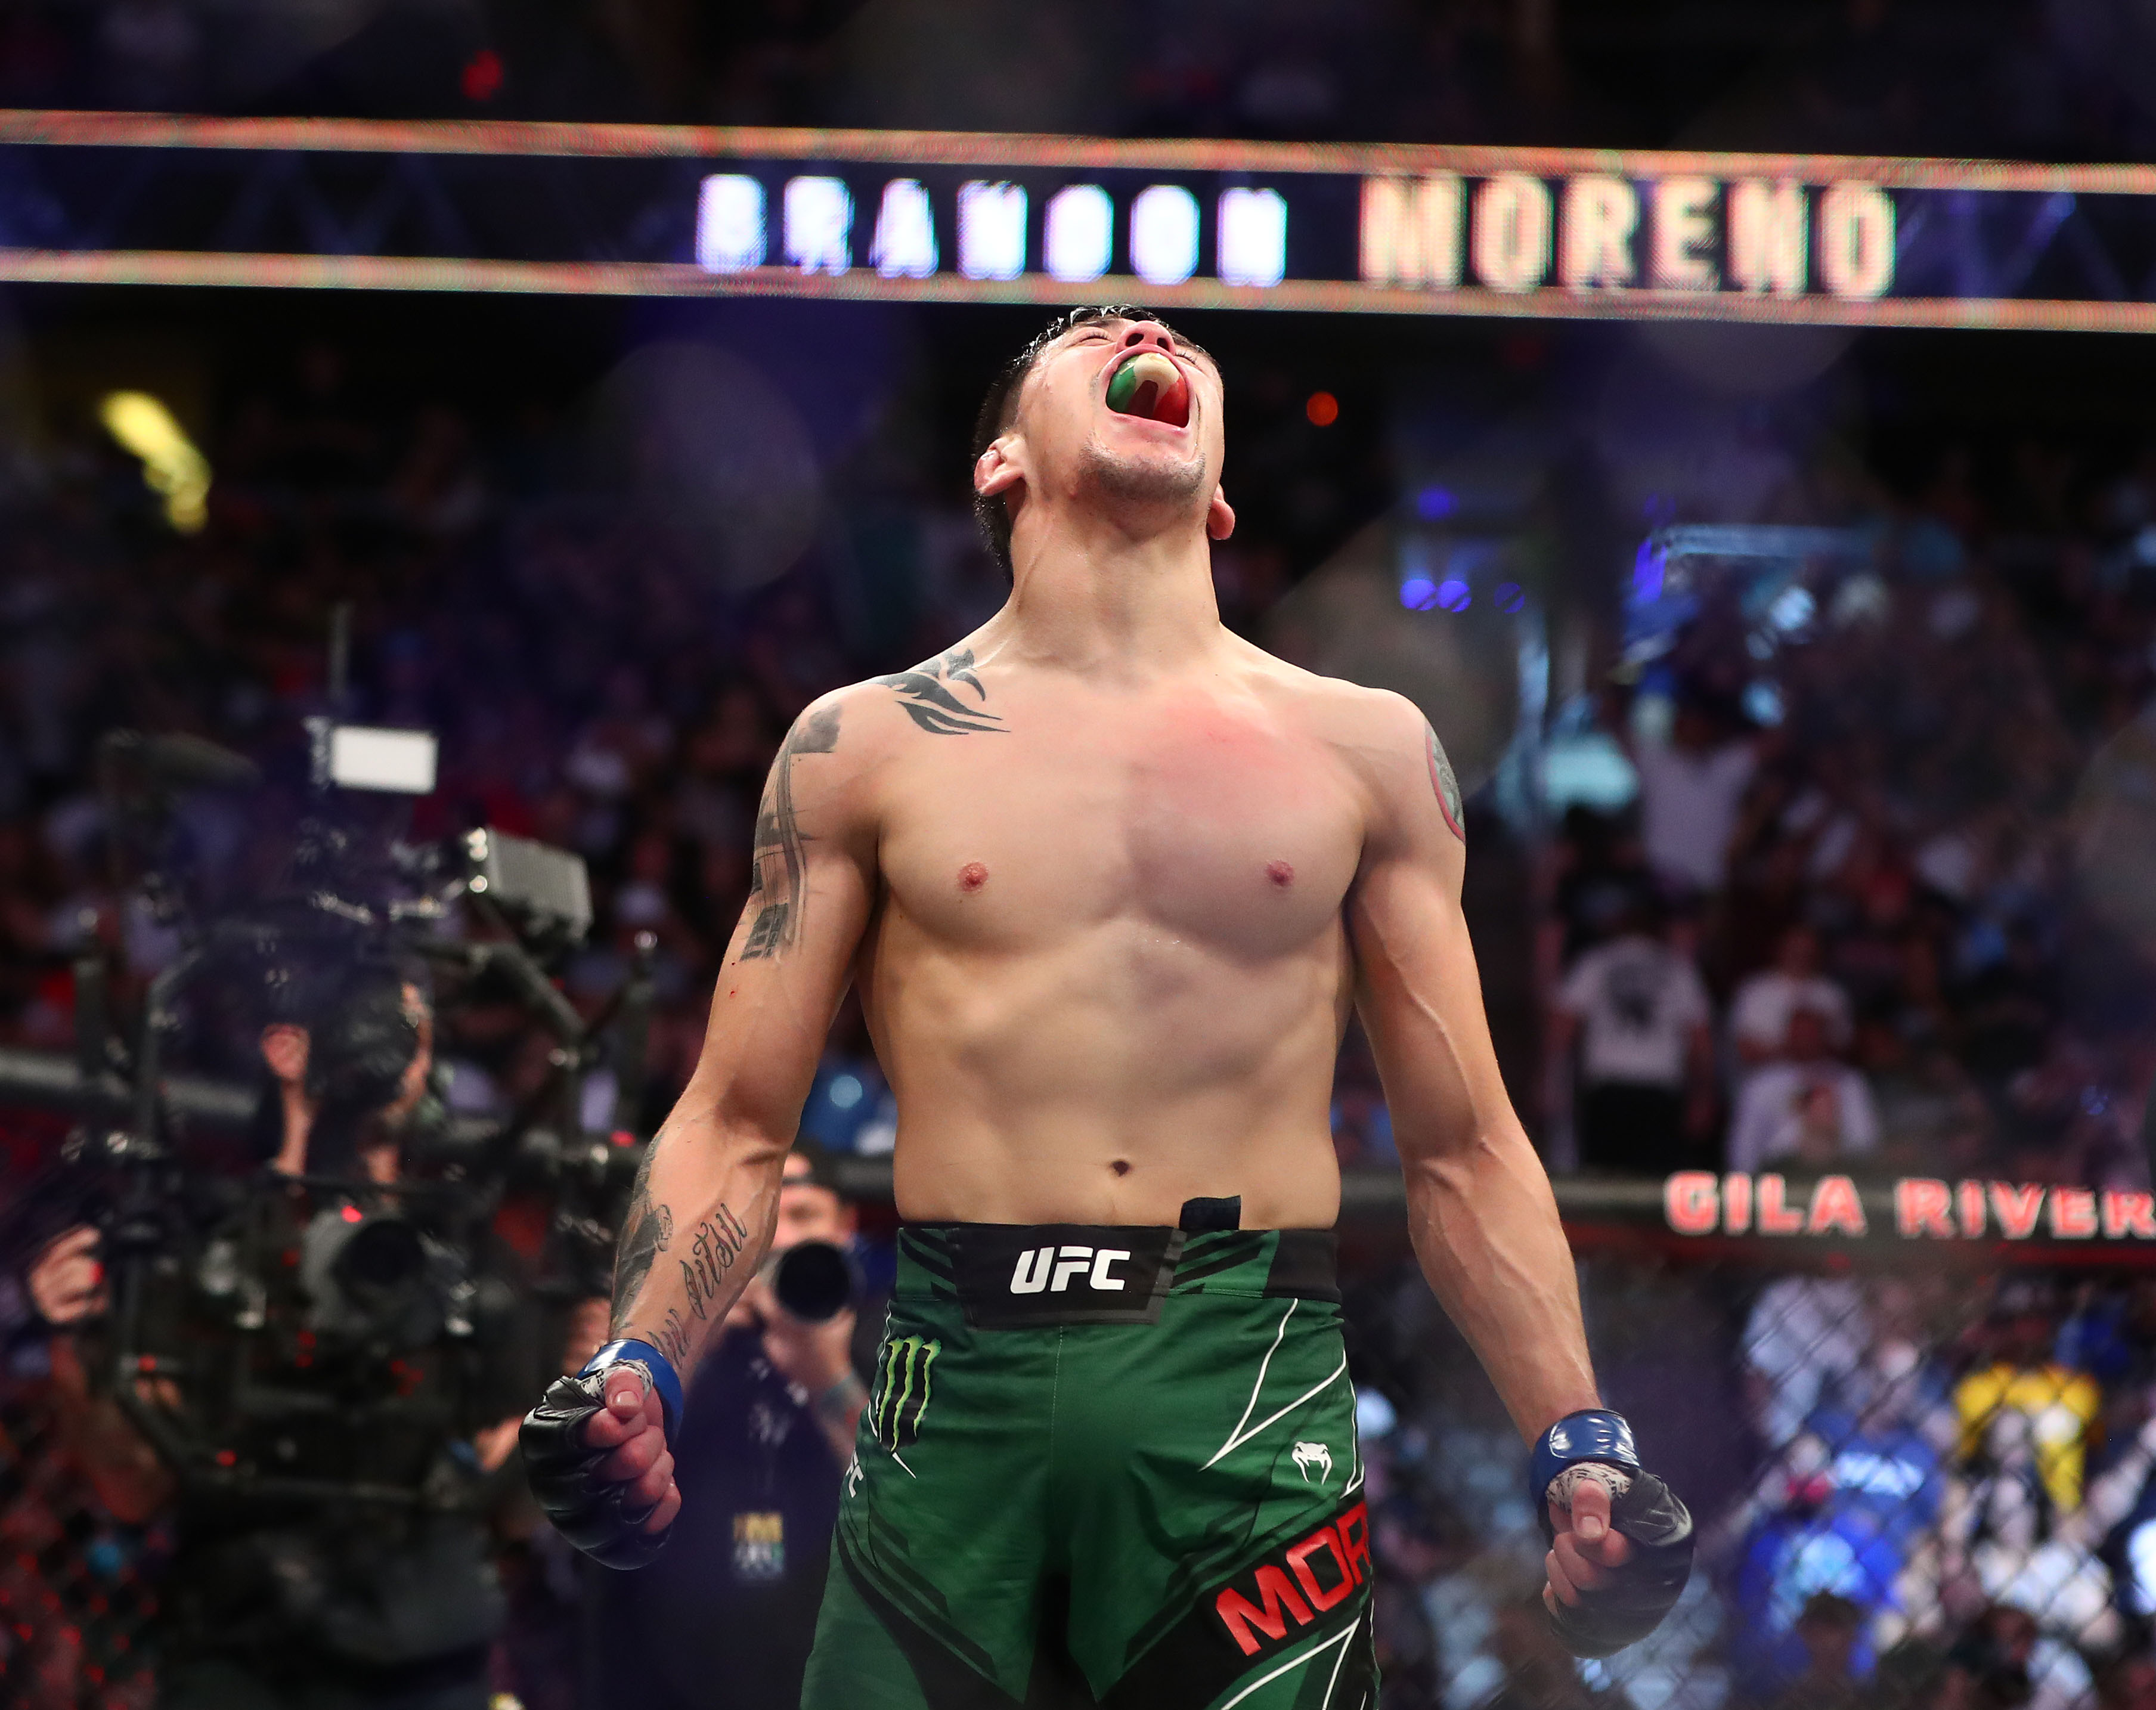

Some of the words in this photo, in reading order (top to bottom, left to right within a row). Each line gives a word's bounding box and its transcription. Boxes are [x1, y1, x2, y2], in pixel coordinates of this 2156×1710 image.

[1358, 169, 1897, 301] MORENO
[1666, 1170, 1866, 1235] GILA
[1895, 1178, 2156, 1239] RIVER
[1010, 1246, 1130, 1294] UFC
